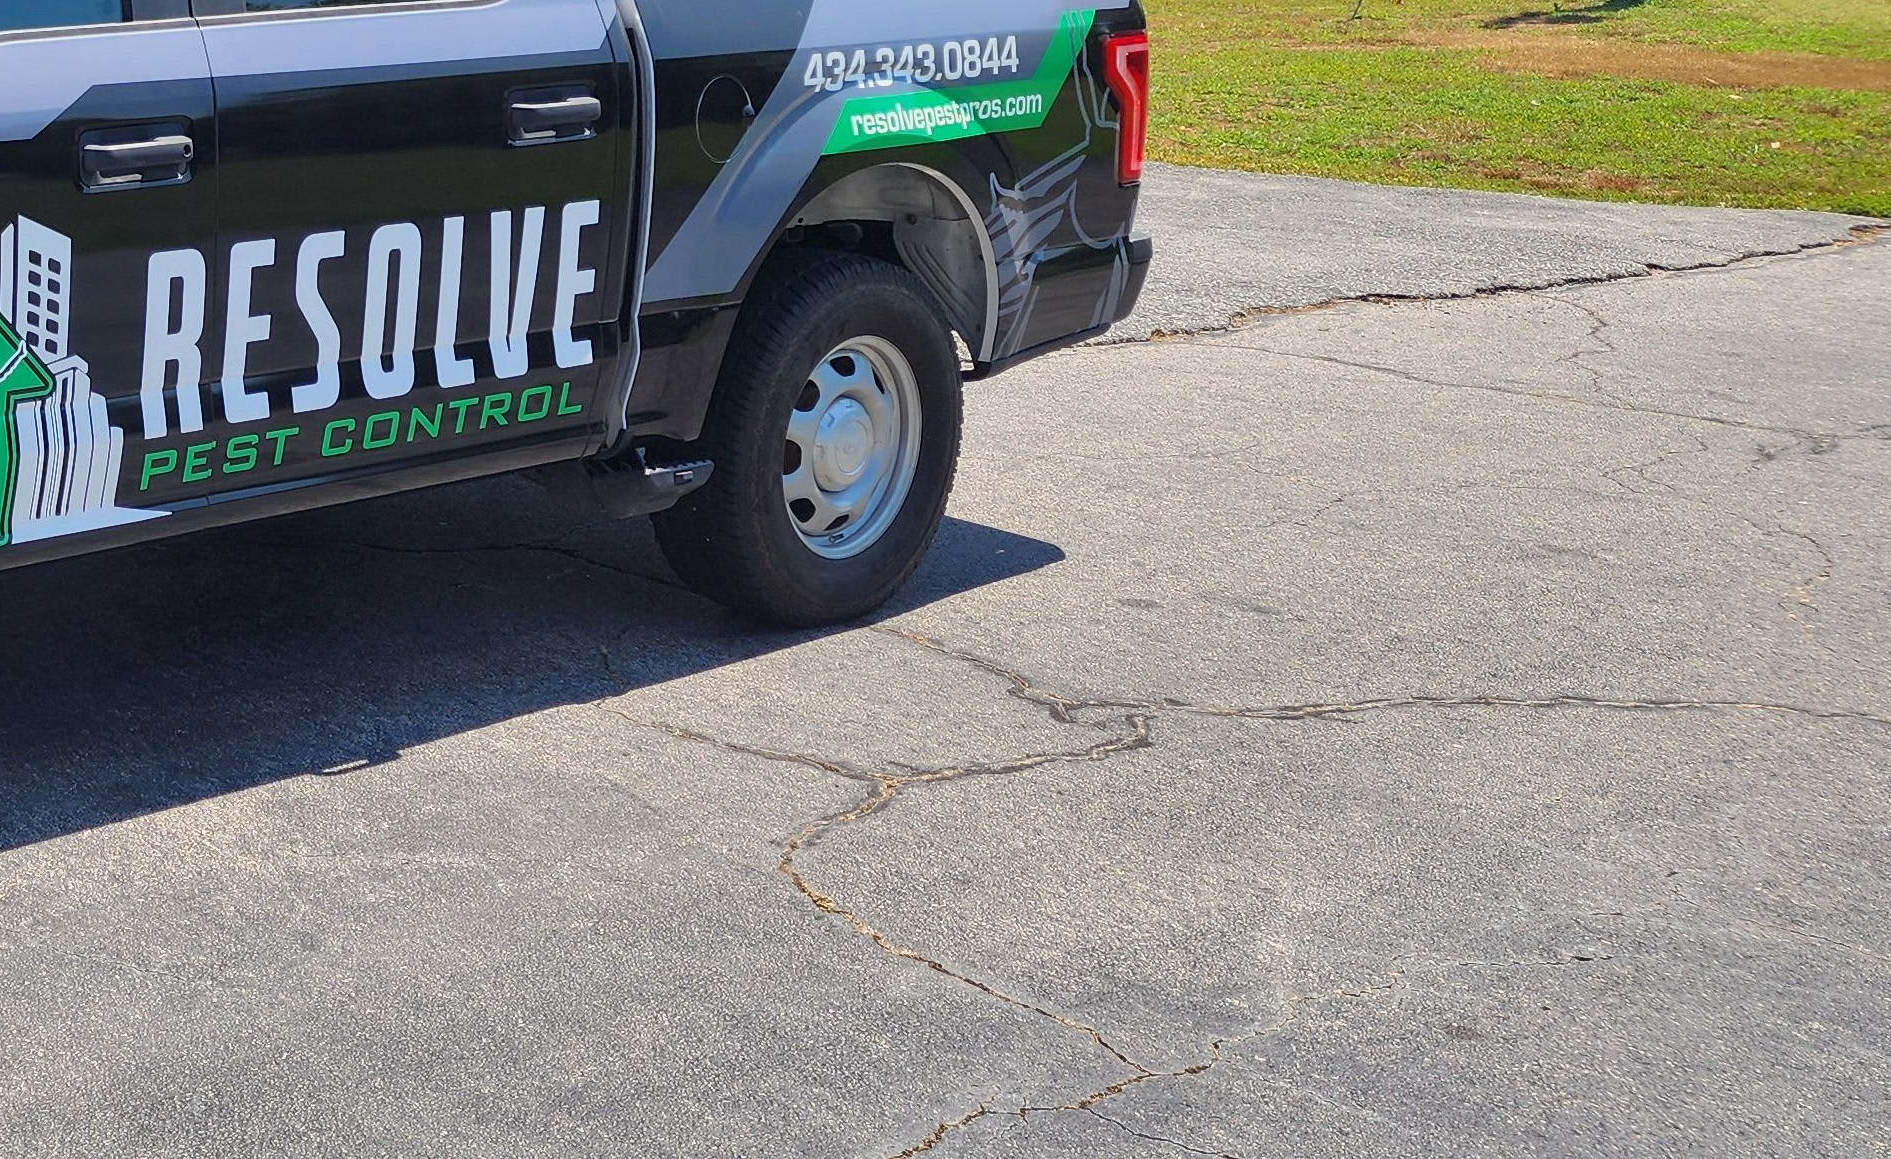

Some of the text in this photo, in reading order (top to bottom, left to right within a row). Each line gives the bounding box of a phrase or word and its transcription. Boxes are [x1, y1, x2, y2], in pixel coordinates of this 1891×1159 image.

[804, 35, 1019, 93] 434.343.0844
[851, 93, 1042, 136] resolvepestpros.com
[140, 199, 600, 440] RESOLVE
[139, 382, 584, 491] PEST CONTROL
